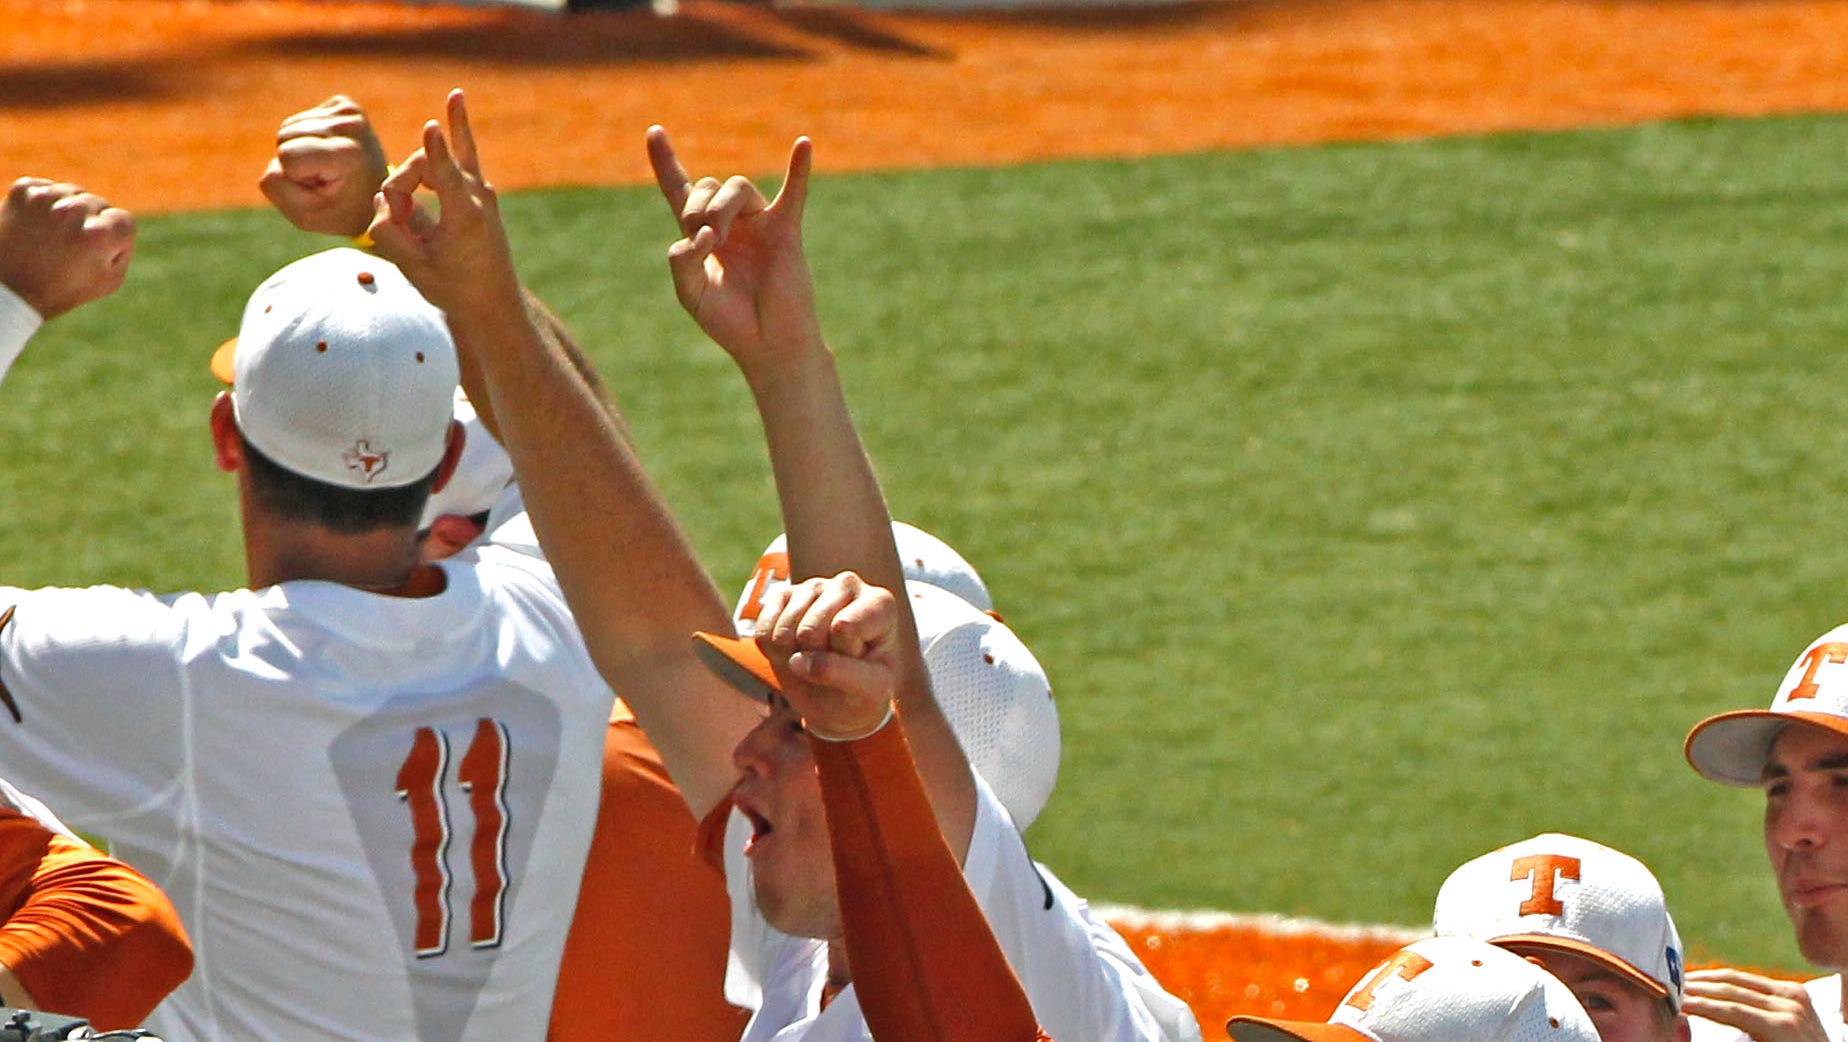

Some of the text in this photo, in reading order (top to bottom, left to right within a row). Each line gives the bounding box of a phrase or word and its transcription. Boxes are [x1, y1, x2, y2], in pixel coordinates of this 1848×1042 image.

[394, 717, 511, 958] 11
[1510, 853, 1581, 916] T
[1345, 950, 1434, 1012] T
